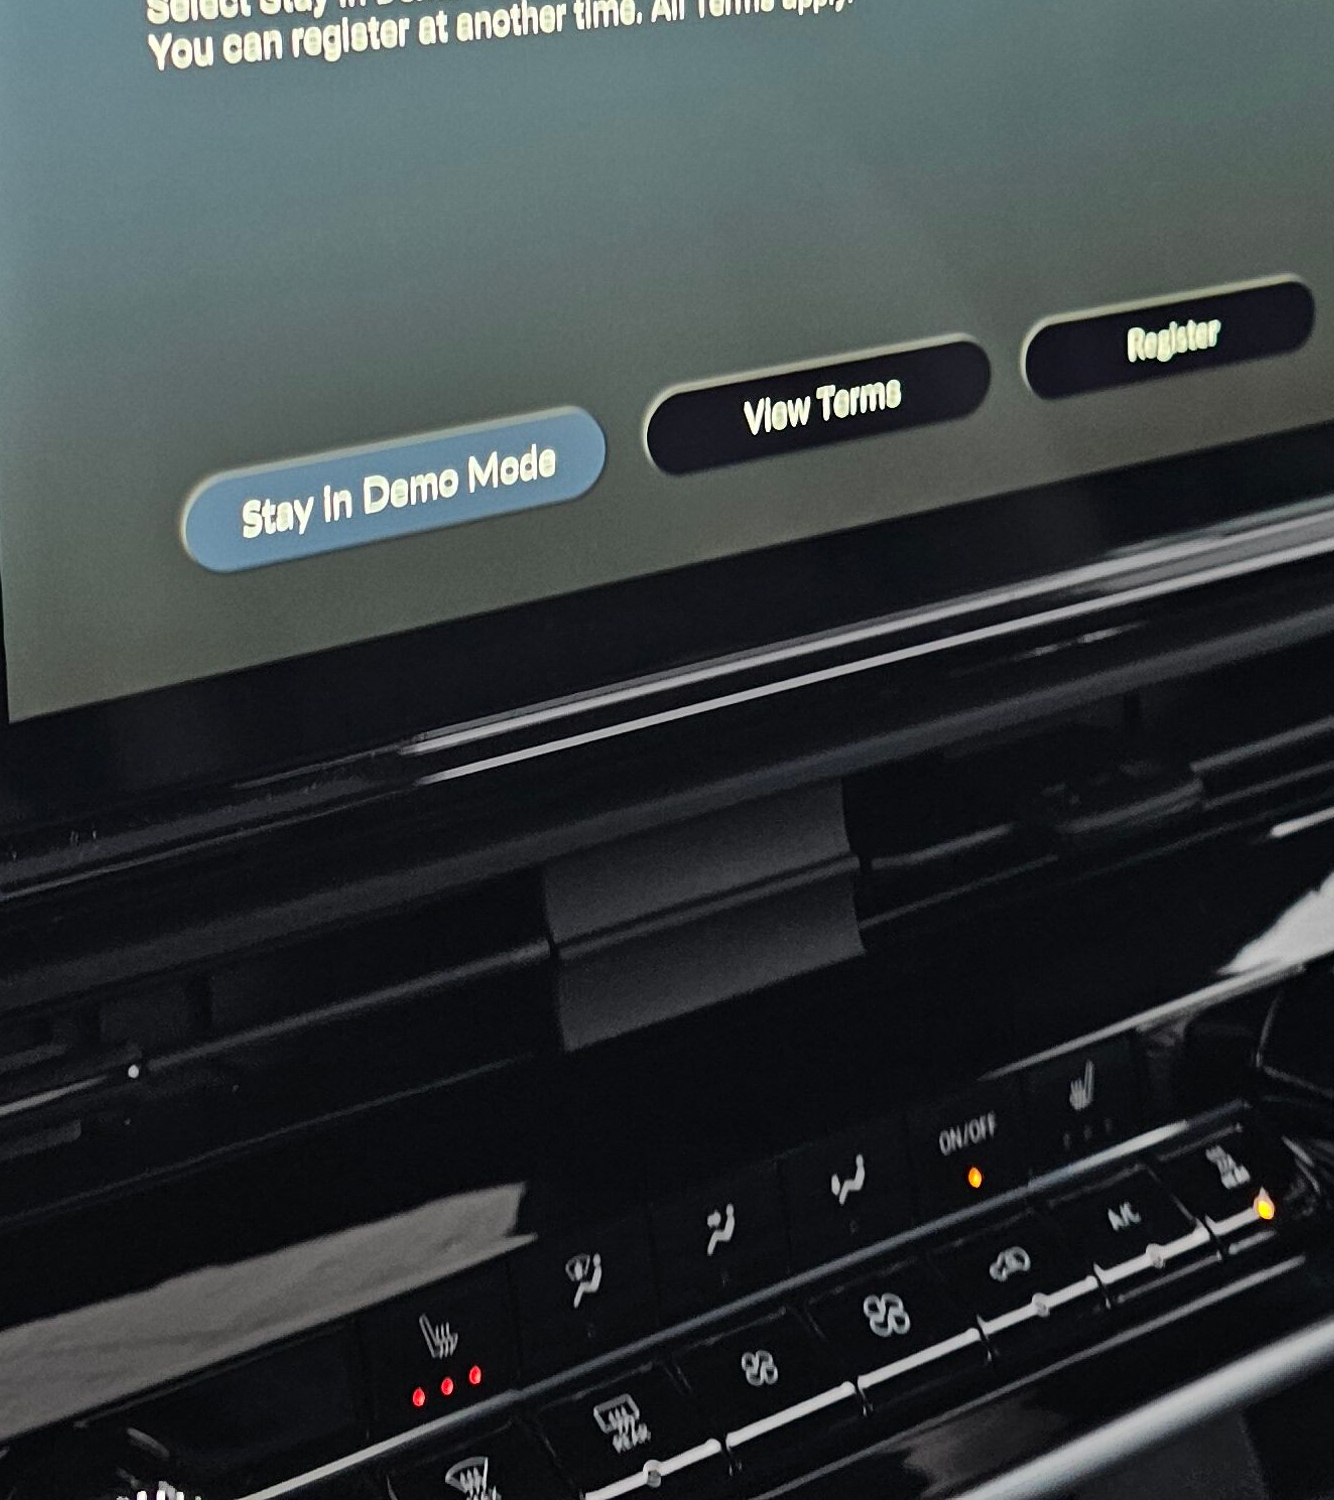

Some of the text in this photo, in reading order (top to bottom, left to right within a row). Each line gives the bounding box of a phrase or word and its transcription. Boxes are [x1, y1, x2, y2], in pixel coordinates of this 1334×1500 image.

[148, 32, 214, 72] You
[223, 28, 283, 65] can
[292, 16, 411, 62] register
[418, 10, 449, 45] at
[1127, 318, 1222, 364] Register
[743, 378, 902, 436] View Terms
[241, 496, 315, 540] Stay
[362, 467, 459, 516] Demo
[468, 443, 557, 494] Mode
[938, 1110, 997, 1157] ON/OFF
